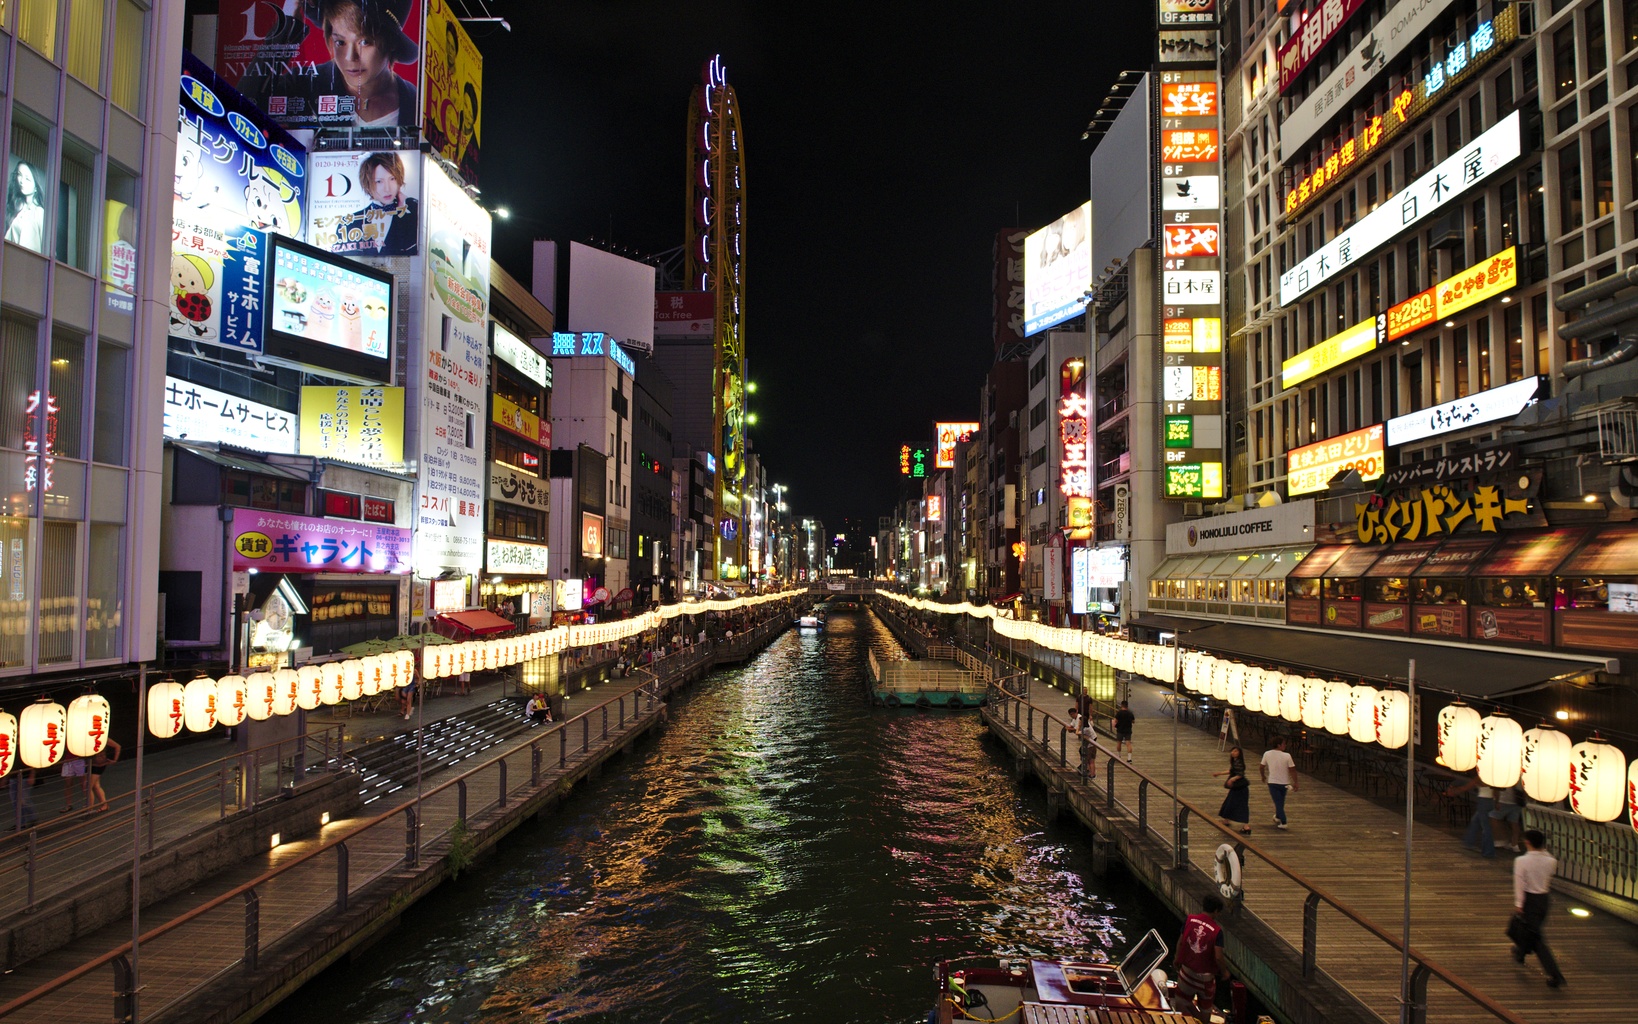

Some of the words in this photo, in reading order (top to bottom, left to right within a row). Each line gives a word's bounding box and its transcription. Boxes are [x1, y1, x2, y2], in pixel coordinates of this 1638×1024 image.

[1164, 12, 1178, 22] 9F
[1301, 0, 1355, 62] 相席
[224, 60, 320, 78] NYANNYA
[425, 56, 452, 99] HOST
[426, 41, 460, 96] OSAKA
[191, 81, 215, 112] 賃貸
[235, 116, 260, 146] リフォーム
[1363, 89, 1413, 151] はや
[1163, 144, 1218, 161] ダイニング
[1171, 132, 1195, 145] 相席
[1401, 146, 1486, 226] 白木屋
[314, 205, 408, 228] モンスターグループ
[1174, 213, 1190, 222] 5F
[1166, 228, 1218, 256] はや
[1166, 259, 1185, 270] 4F
[1297, 237, 1352, 293] 白木屋
[1168, 277, 1215, 294] 白木屋
[226, 290, 240, 340] サービス
[240, 256, 261, 348] 富士ホーム
[672, 310, 692, 320] Free
[552, 331, 604, 356] 無双
[165, 382, 290, 434] 士ホームサービス
[1059, 392, 1088, 496] 大阪王将
[1386, 450, 1512, 485] ハンバーグレストラン
[421, 494, 449, 512] コスパ
[500, 472, 537, 505] うなぎ
[364, 503, 386, 518] たばこ
[1355, 484, 1528, 545] びっくりドンキー
[257, 517, 373, 538] あなたも憧れのお店のオーナーに!
[1200, 525, 1238, 540] HONOLULU
[1238, 520, 1272, 534] COFFEE
[240, 537, 268, 553] 賃貸
[274, 534, 374, 566] ギャラント
